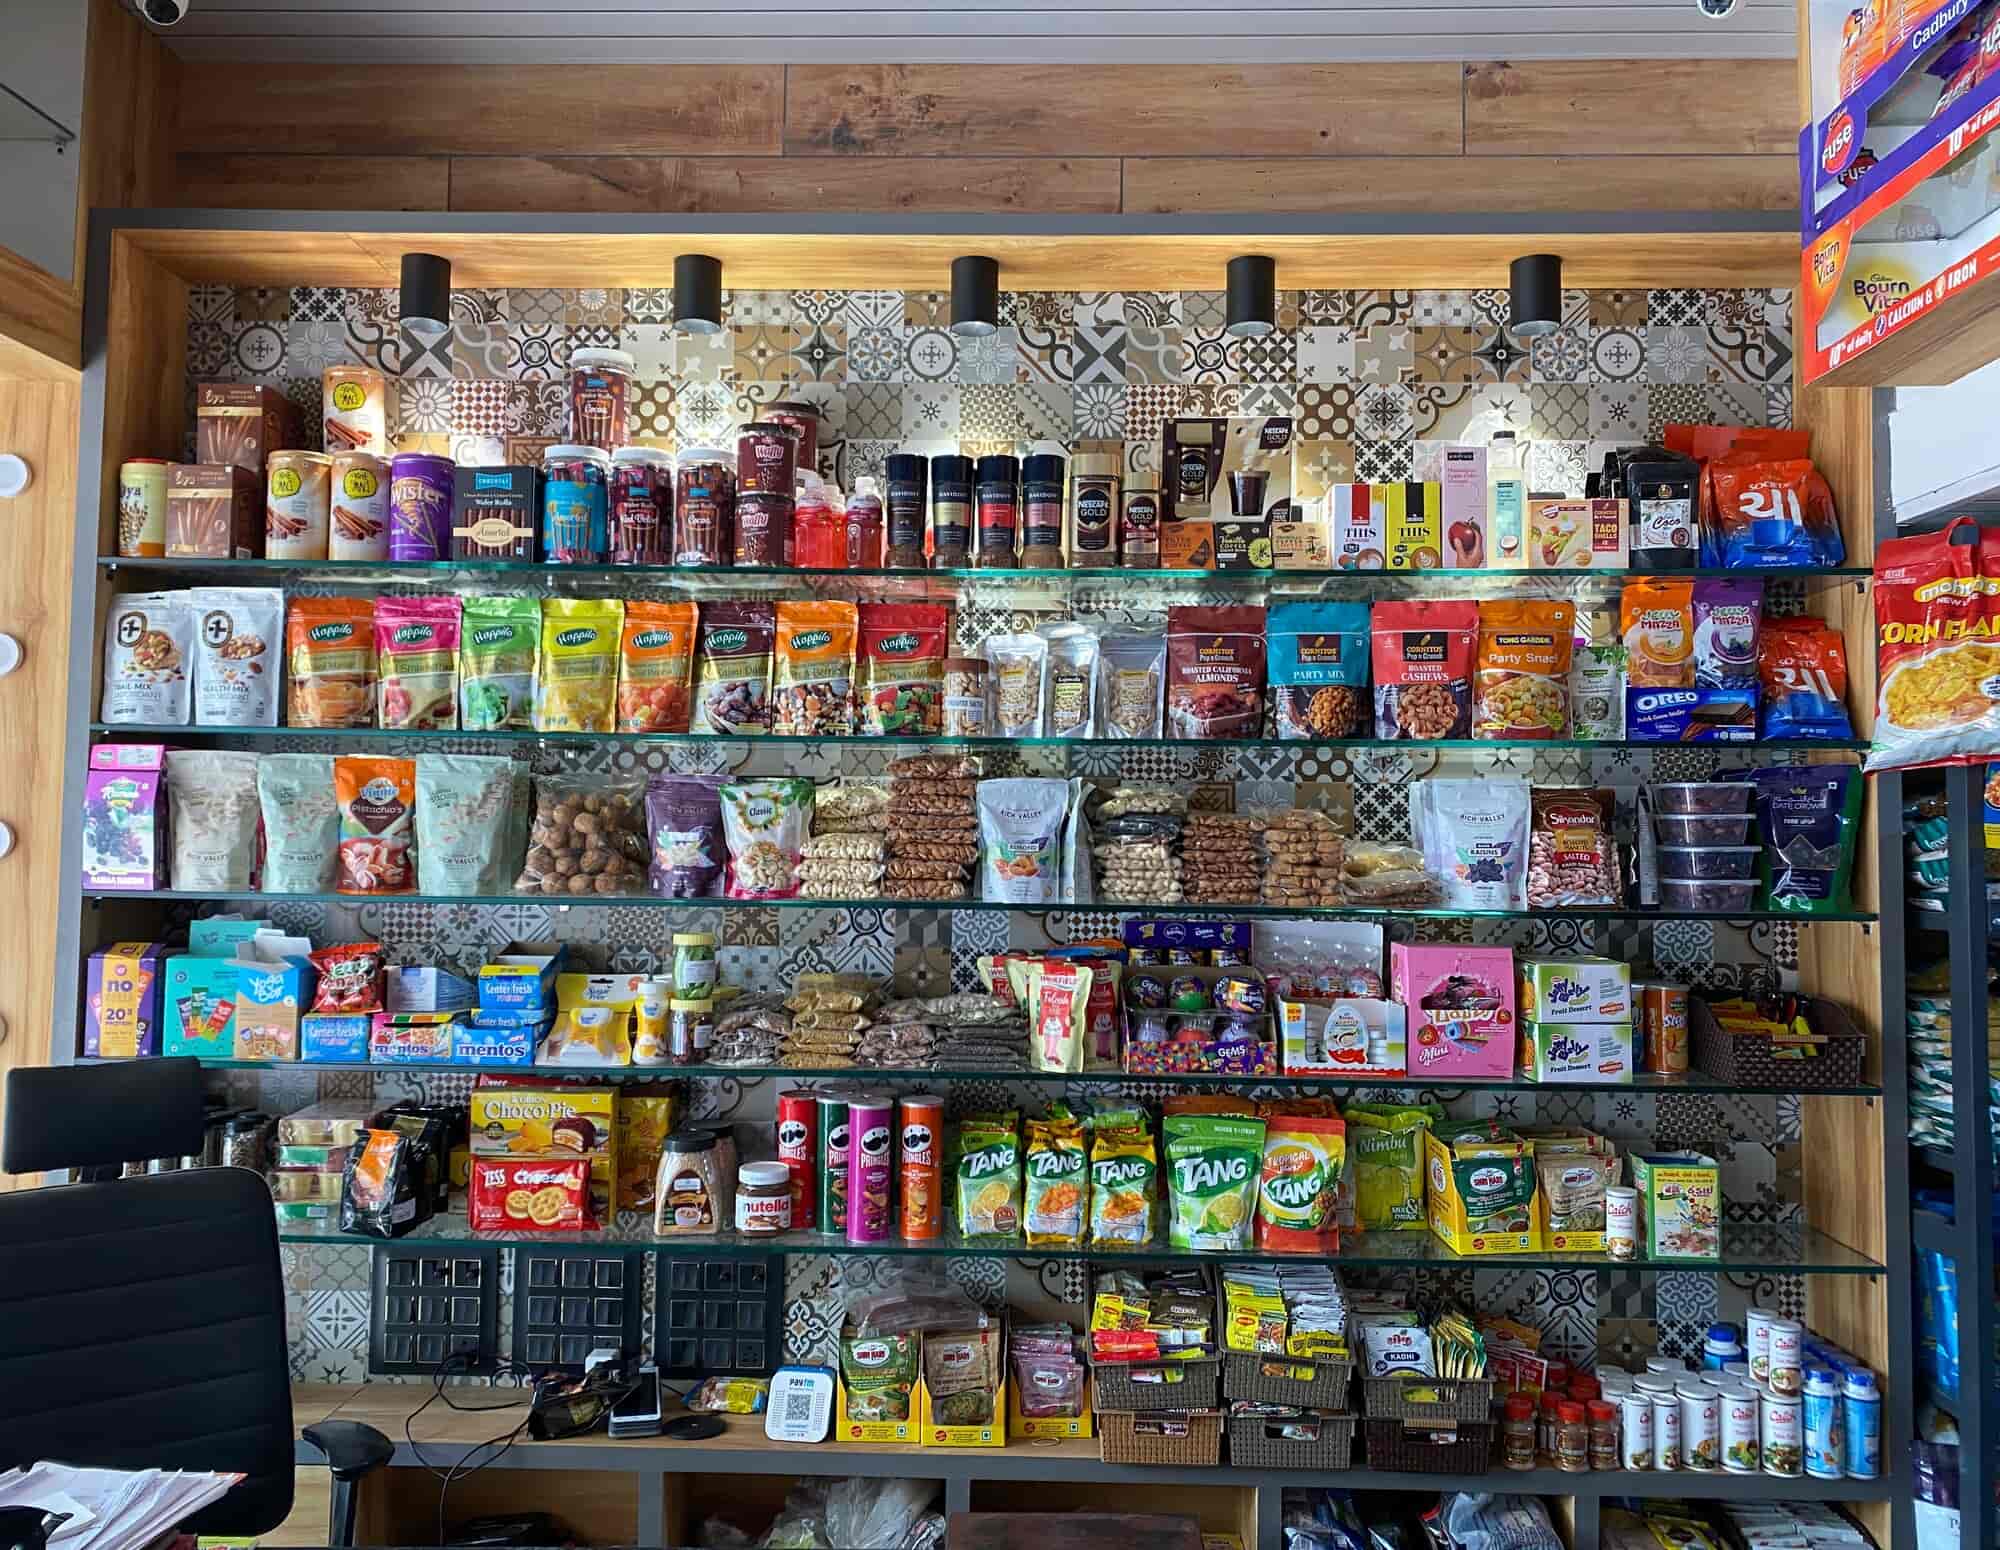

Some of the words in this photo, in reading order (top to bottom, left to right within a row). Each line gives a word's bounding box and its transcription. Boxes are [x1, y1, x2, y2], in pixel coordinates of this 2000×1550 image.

[1912, 0, 1969, 49] Cadbury
[1853, 279, 1910, 296] Bourn
[1888, 294, 1924, 328] CALCIUM
[1946, 259, 1977, 291] IRON
[1080, 508, 1107, 517] GOLD
[1594, 524, 1618, 533] TACO
[1880, 617, 1941, 647] ORN
[1489, 654, 1521, 665] Party
[1195, 673, 1239, 682] ALMONDS
[1293, 670, 1323, 680] PARTY
[1327, 670, 1345, 681] MIX
[1401, 672, 1449, 681] CASHEWS
[1636, 691, 1698, 711] OREO
[749, 806, 773, 817] Classic
[106, 980, 133, 992] no
[459, 1043, 527, 1058] mentos
[1218, 1046, 1247, 1058] GEMS
[484, 1101, 544, 1120] Choco
[546, 1101, 577, 1120] Pie
[901, 1150, 932, 1166] PRINGLES
[961, 1149, 1016, 1178] TANG
[1027, 1151, 1083, 1177] TANG
[1093, 1160, 1147, 1186] TANG
[1174, 1157, 1248, 1193] TANG
[1272, 1176, 1321, 1204] TANG
[742, 1199, 790, 1213] nutella
[1607, 1203, 1633, 1216] Catch
[1390, 1352, 1415, 1361] KADHI
